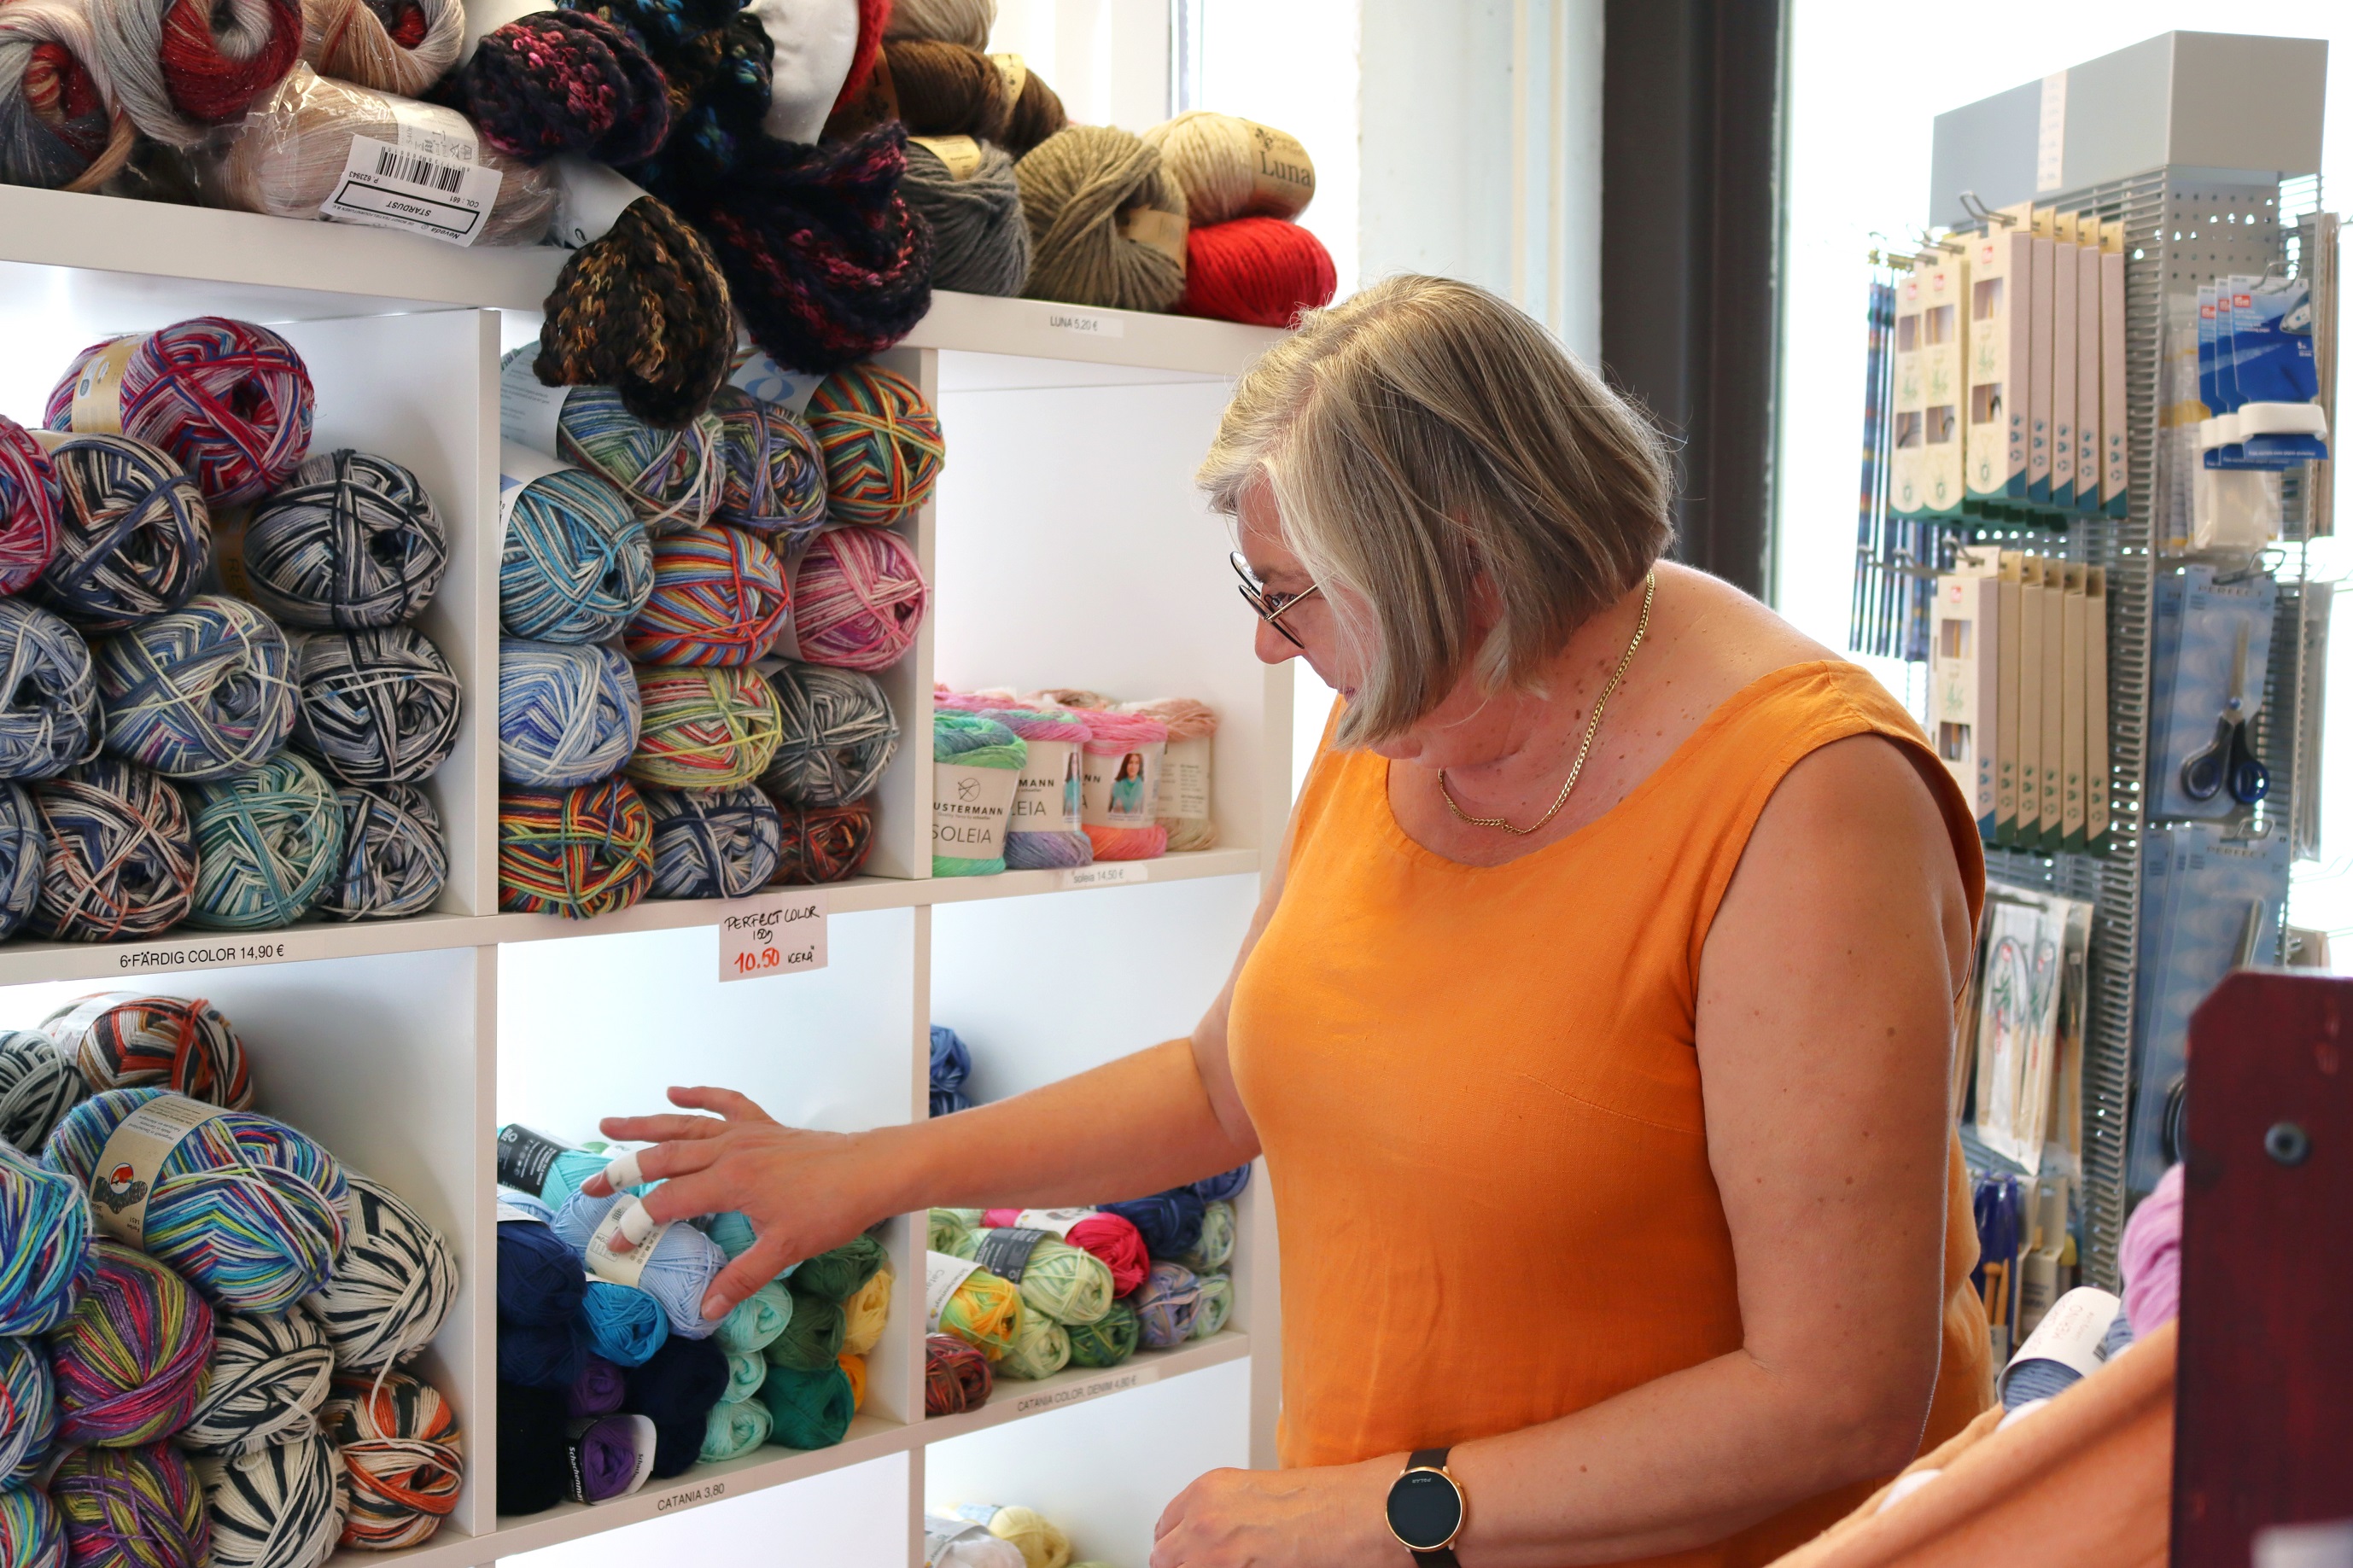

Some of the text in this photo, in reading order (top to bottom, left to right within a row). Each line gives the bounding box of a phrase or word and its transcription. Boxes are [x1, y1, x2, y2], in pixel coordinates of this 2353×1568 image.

[348, 171, 371, 182] 623943
[1258, 150, 1311, 187] Luna
[386, 200, 431, 217] STARDUST
[1050, 316, 1072, 328] LUNA
[1093, 320, 1098, 331] €
[932, 824, 991, 843] SOLEIA
[1073, 872, 1095, 883] soleia
[1118, 869, 1124, 879] €
[724, 906, 820, 931] PERFECT COLOR
[188, 947, 236, 963] COLOR
[241, 945, 273, 960] 14,90
[277, 944, 284, 957] €
[734, 947, 779, 973] 10.50
[1018, 1395, 1054, 1412] CATANIA
[1087, 1381, 1112, 1396] DENIM
[657, 1483, 725, 1511] CATANIA 3,80
